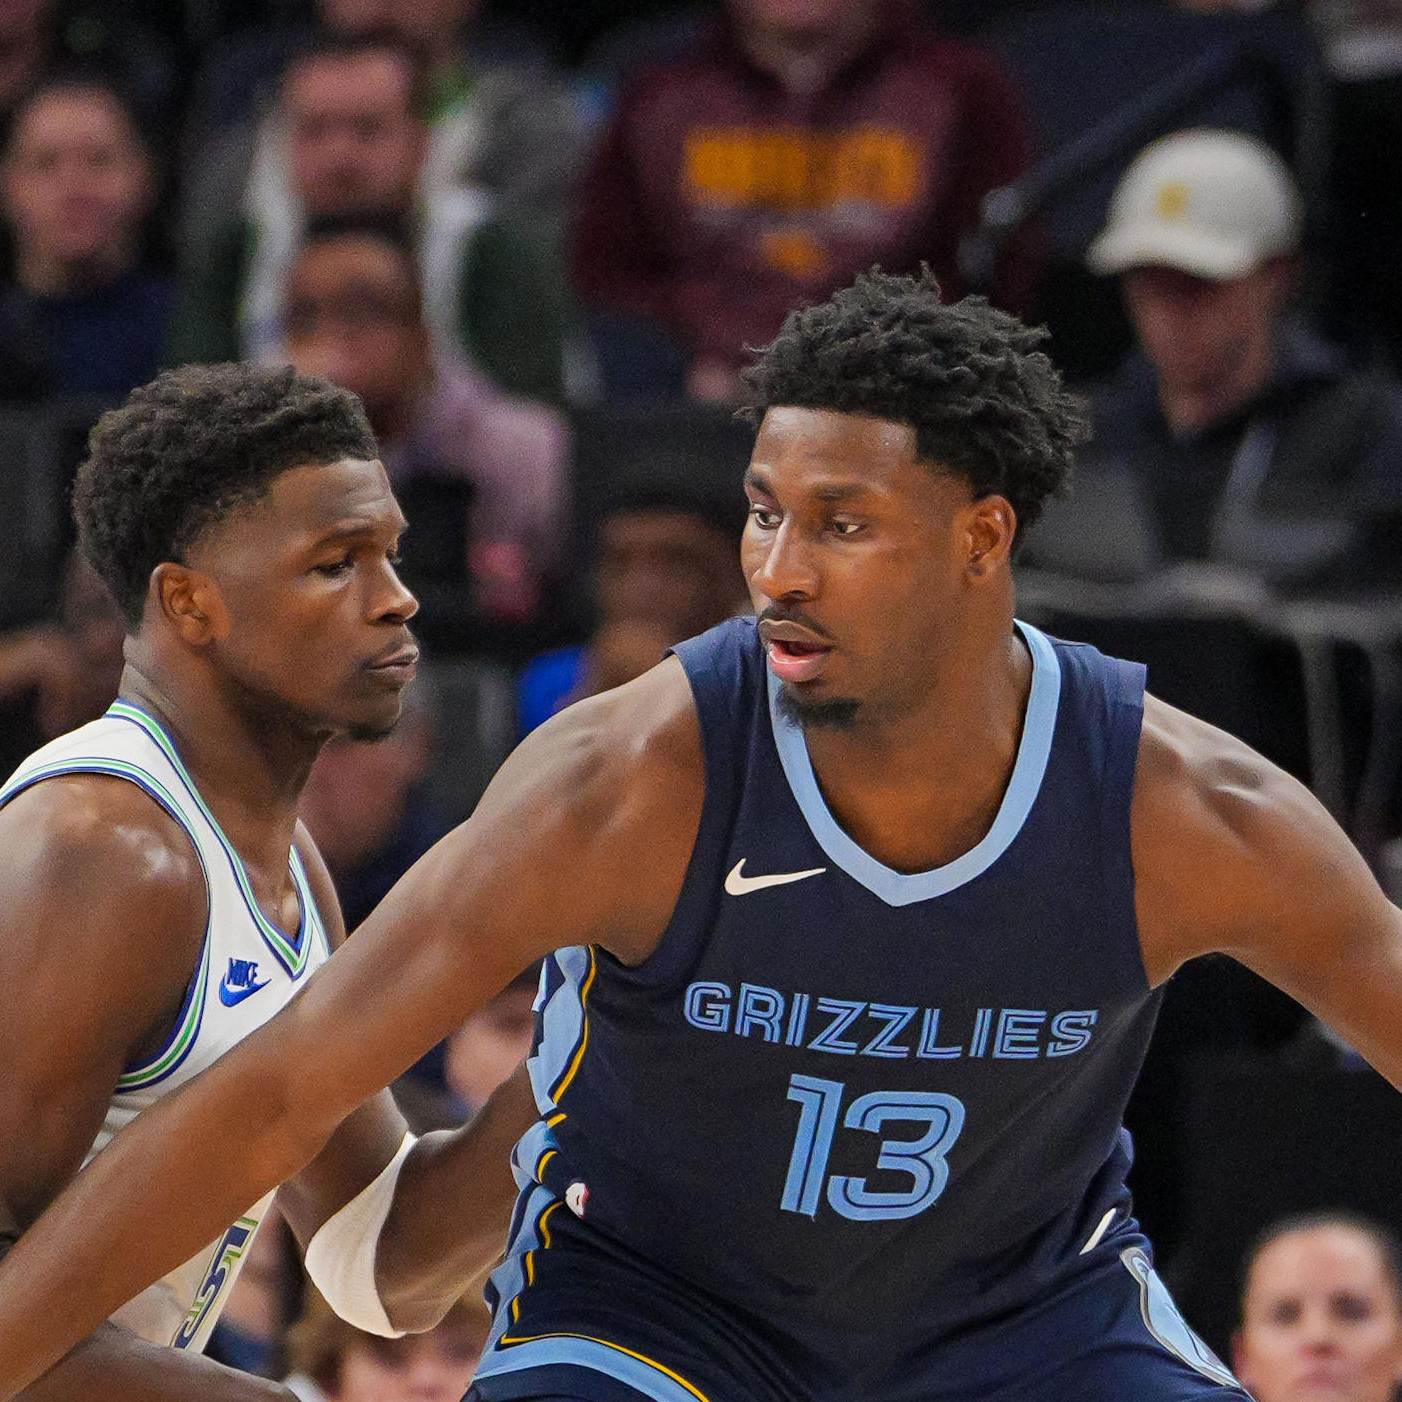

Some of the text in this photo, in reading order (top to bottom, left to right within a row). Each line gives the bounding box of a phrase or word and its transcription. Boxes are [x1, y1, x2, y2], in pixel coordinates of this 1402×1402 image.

[226, 957, 259, 988] NIKE
[684, 981, 1098, 1060] GRIZZLIES
[780, 1073, 966, 1221] 13
